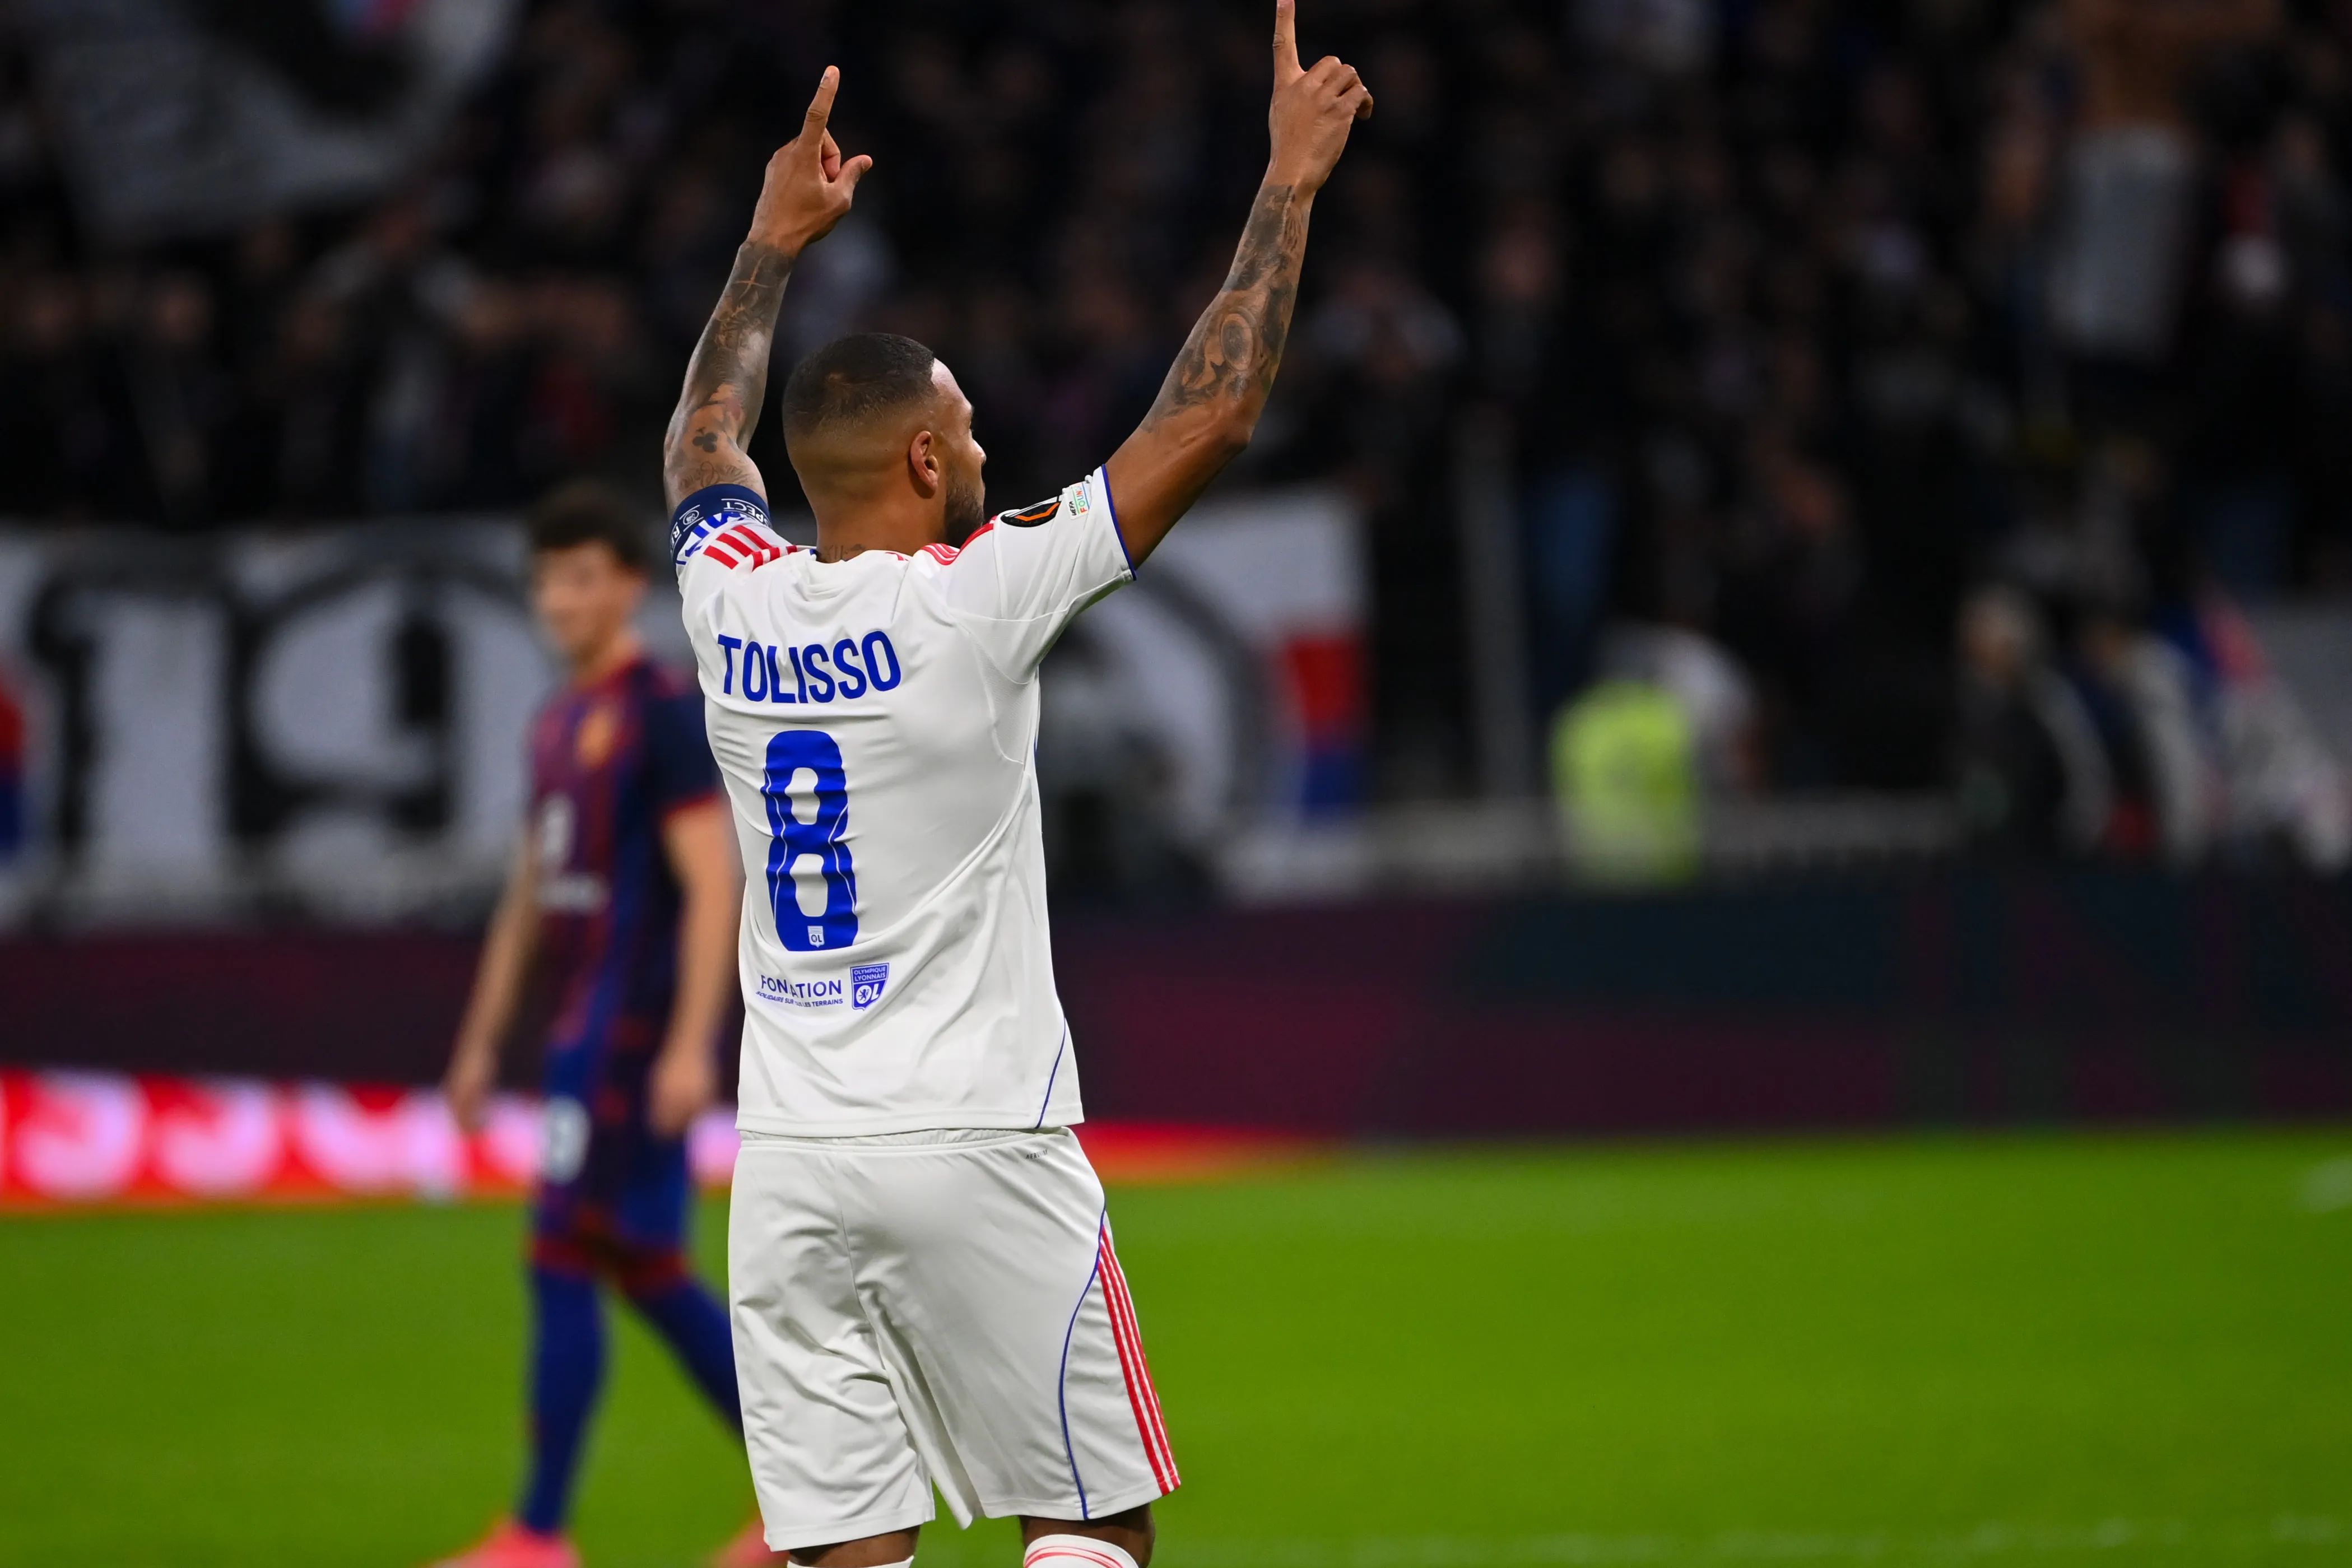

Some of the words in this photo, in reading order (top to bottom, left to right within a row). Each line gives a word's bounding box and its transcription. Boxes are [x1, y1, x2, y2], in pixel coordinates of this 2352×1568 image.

[1068, 501, 1077, 516] UEFA
[717, 630, 901, 704] TOLISSO
[760, 729, 858, 952] 8
[811, 934, 822, 943] OL
[854, 966, 886, 975] OLYMPIQUE
[854, 972, 886, 981] LYONNAIS
[760, 974, 842, 998] FONATION
[856, 983, 879, 1004] OL
[755, 990, 784, 1003] SOLIDAIRE
[811, 998, 843, 1007] TERRAINS
